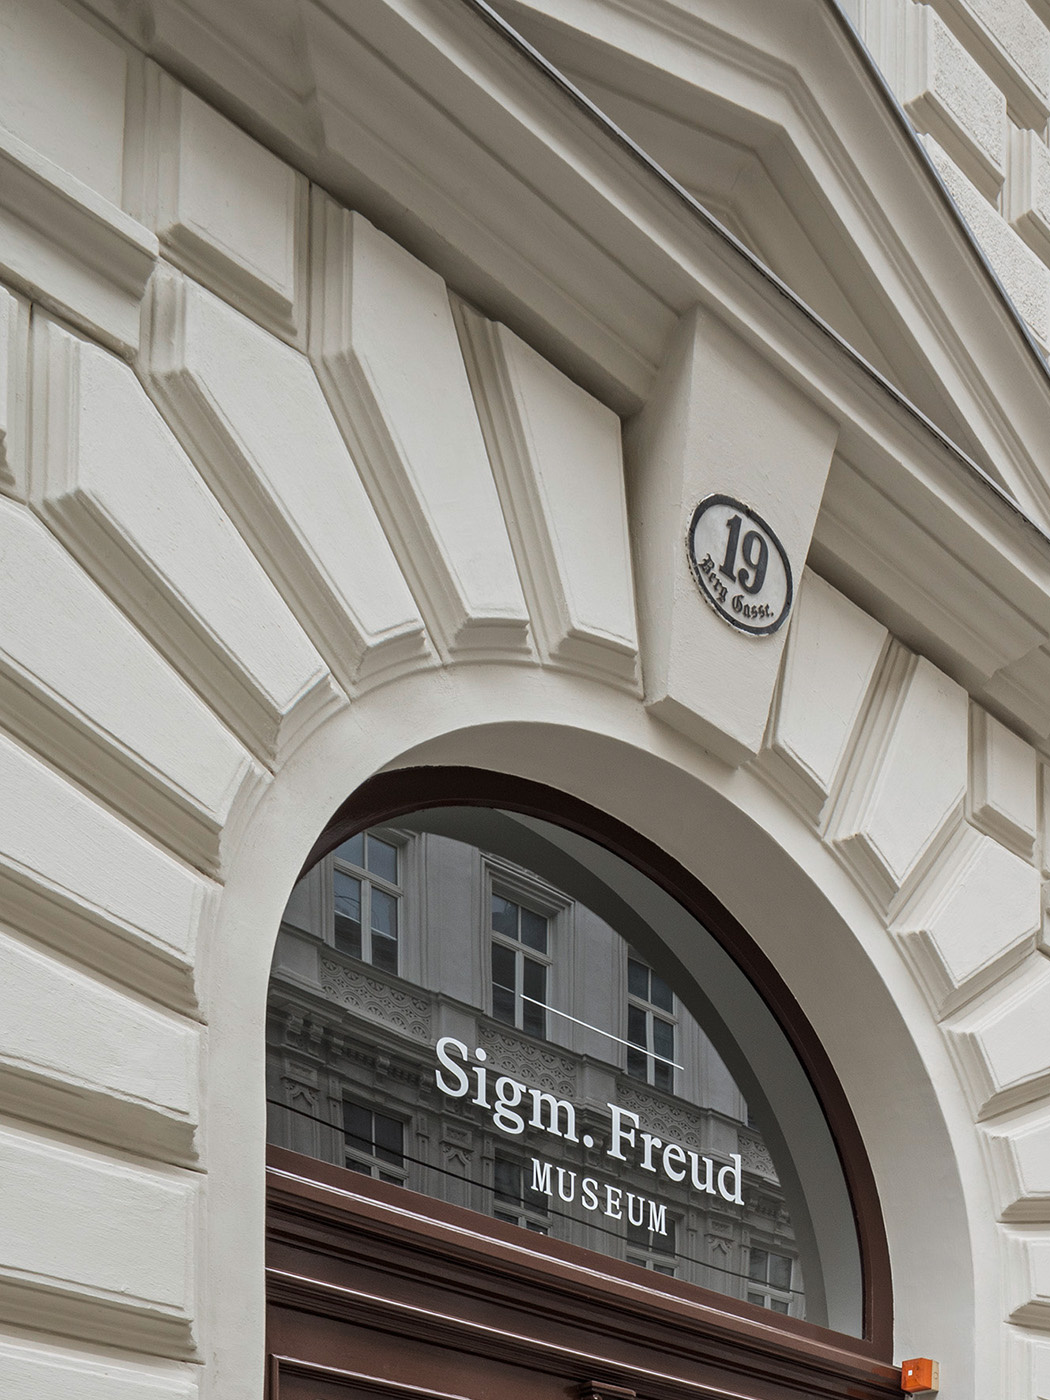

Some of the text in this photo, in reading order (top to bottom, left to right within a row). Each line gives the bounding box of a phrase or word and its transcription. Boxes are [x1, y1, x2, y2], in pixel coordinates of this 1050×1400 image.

[698, 553, 729, 603] Berg
[719, 514, 769, 595] 19
[435, 1036, 745, 1206] Sigm. Freud
[530, 1158, 668, 1236] MUSEUM
